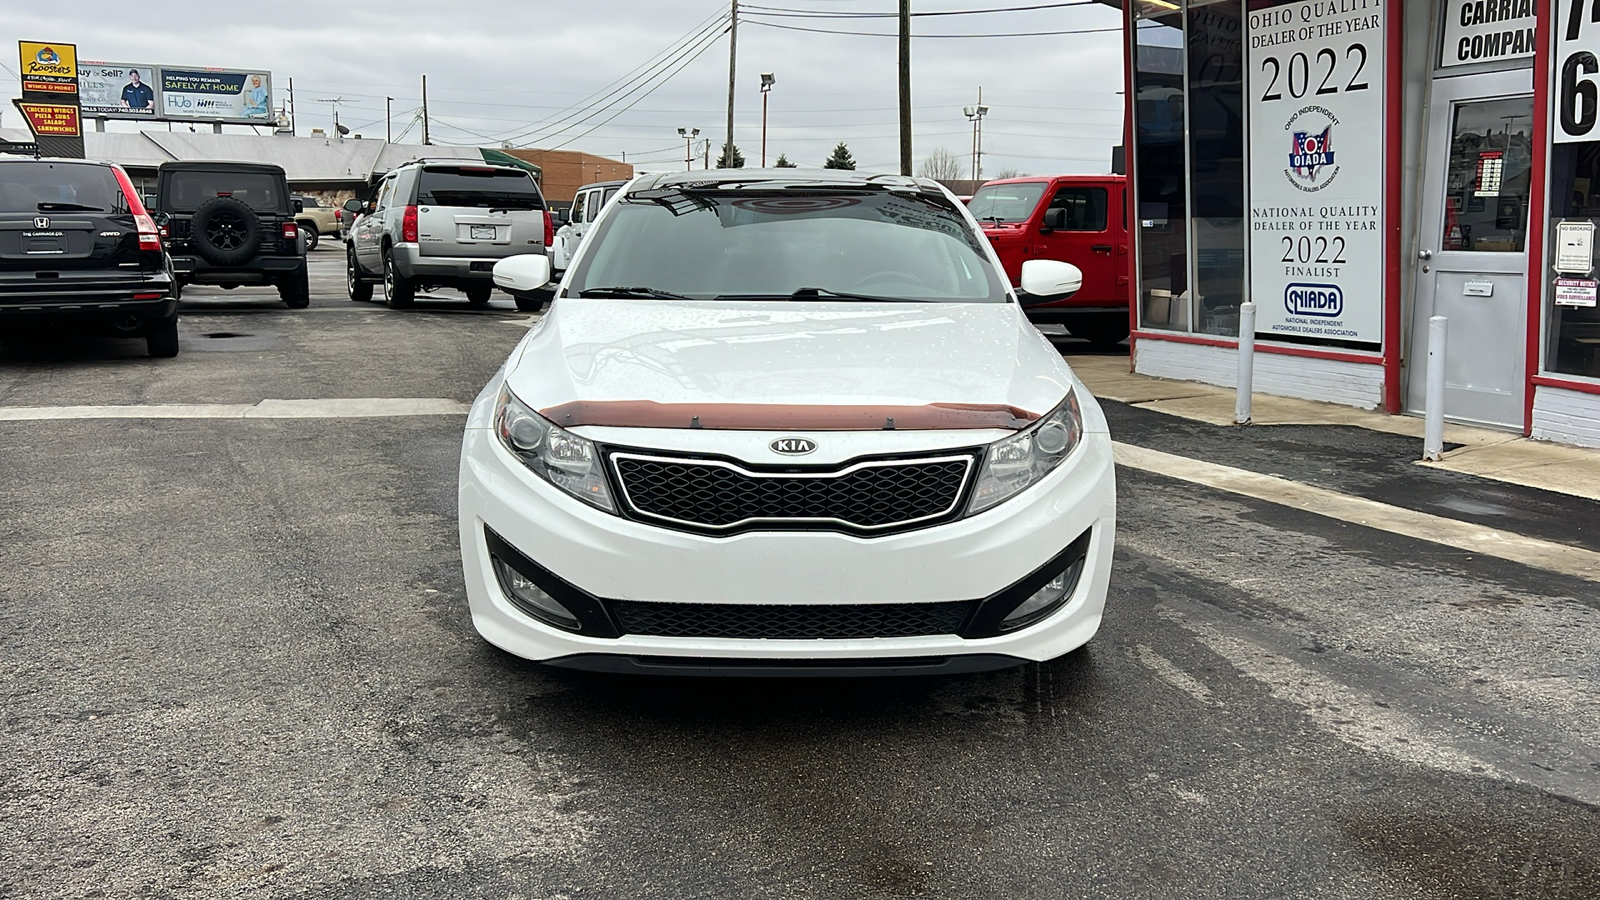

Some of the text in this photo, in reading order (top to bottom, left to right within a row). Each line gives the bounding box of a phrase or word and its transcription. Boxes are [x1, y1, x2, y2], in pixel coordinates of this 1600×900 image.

[1250, 8, 1292, 30] OHIO
[1252, 14, 1380, 49] DEALER OF THE YEAR
[27, 61, 71, 74] Roosters
[77, 69, 91, 77] uy
[101, 69, 123, 77] Sell?
[1261, 43, 1369, 102] 2022
[165, 81, 197, 89] SAFELY
[213, 84, 239, 92] HOME
[1560, 50, 1599, 137] 6
[1284, 105, 1340, 131] OHIO INDEPENDENT
[1294, 153, 1327, 166] OIADA
[1252, 205, 1379, 219] NATIONAL QUALITY
[1254, 221, 1376, 231] DEALER OF THE YEAR
[1281, 235, 1347, 264] 2022
[1285, 266, 1340, 278] FINALIST
[1289, 290, 1338, 310] NIADA
[1285, 317, 1343, 327] NATIONAL INDEPENDENT
[1272, 324, 1358, 337] AUTOMOBILE DEALERS ASSOCIATION
[777, 440, 810, 451] KIA
